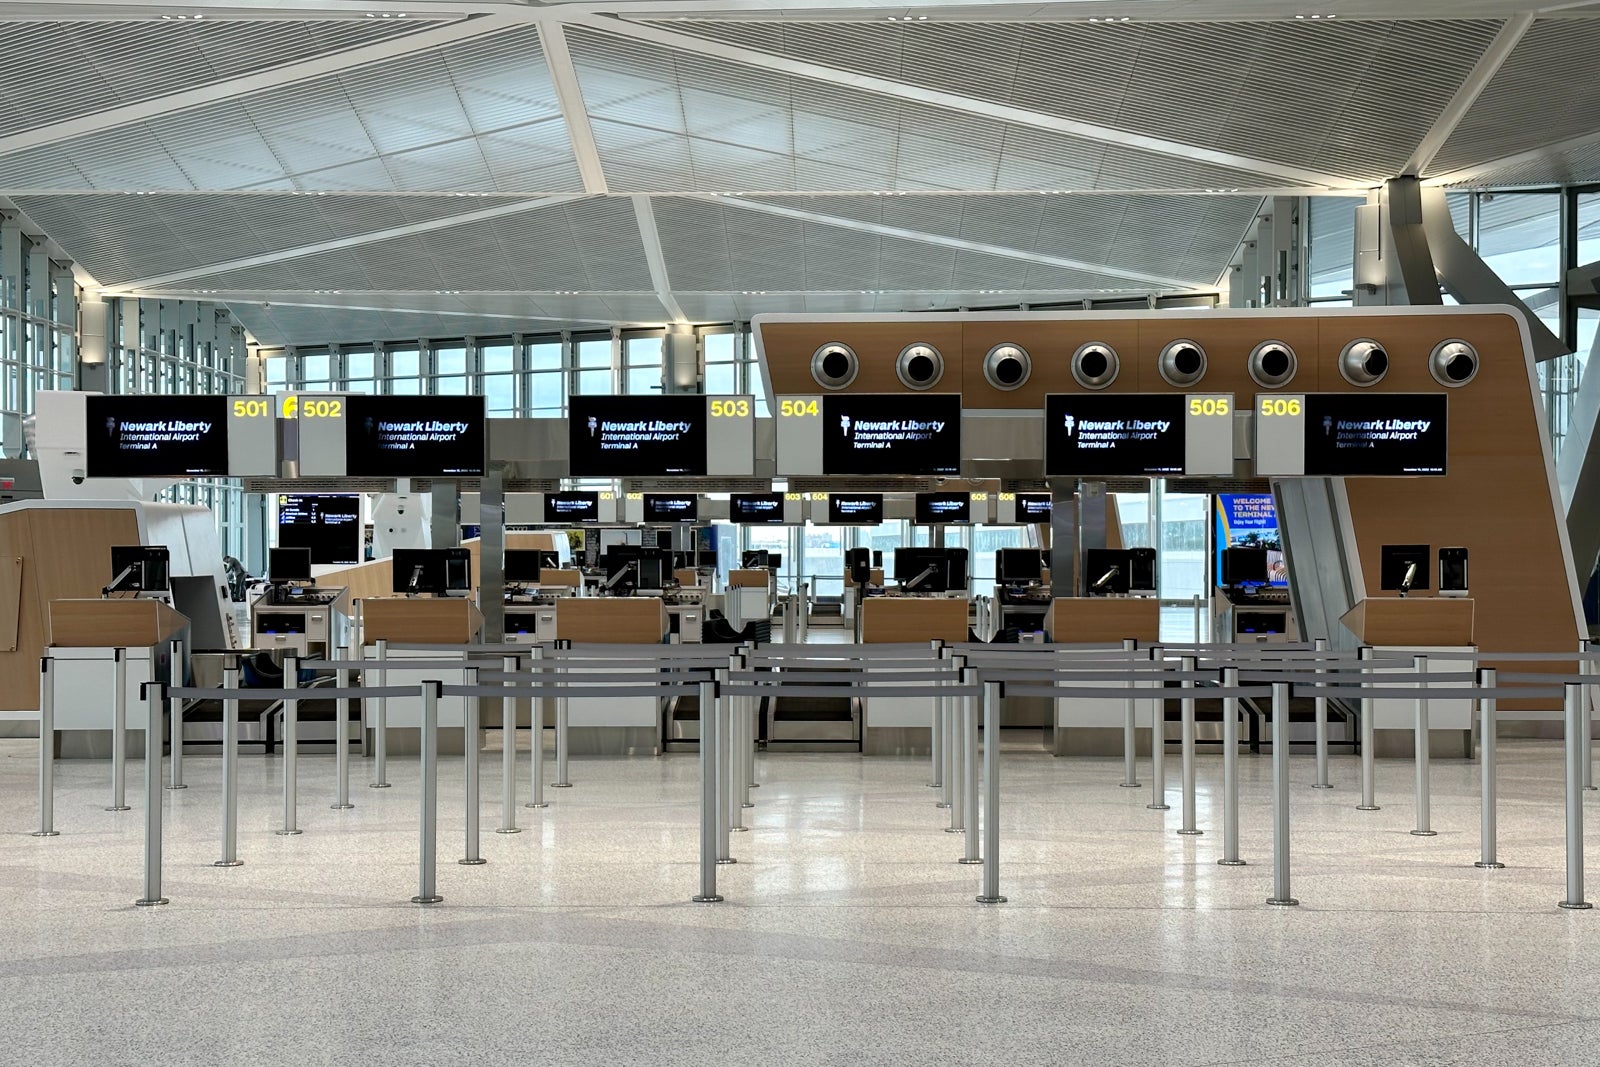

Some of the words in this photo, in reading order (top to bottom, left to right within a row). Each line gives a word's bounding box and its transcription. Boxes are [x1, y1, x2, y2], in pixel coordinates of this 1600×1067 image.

[234, 400, 268, 417] 501
[303, 400, 342, 418] 502
[710, 400, 749, 417] 503
[780, 400, 819, 417] 504
[1189, 398, 1229, 416] 505
[1261, 398, 1302, 417] 506
[120, 421, 167, 431] Newark
[168, 421, 212, 433] Liberty
[378, 421, 424, 431] Newark
[425, 421, 469, 433] Liberty
[601, 421, 647, 431] Newark
[648, 421, 692, 433] Liberty
[854, 420, 900, 431] Newark
[901, 420, 945, 432] Liberty
[1078, 420, 1124, 430] Newark
[1126, 420, 1170, 432] Liberty
[1337, 420, 1384, 430] Newark
[1385, 419, 1431, 432] Liberty
[120, 433, 172, 441] International
[172, 433, 200, 442] Airport
[378, 433, 429, 441] International
[430, 433, 456, 442] Airport
[601, 433, 652, 441] International
[652, 433, 679, 442] Airport
[854, 432, 905, 440] International
[906, 432, 932, 441] Airport
[1078, 432, 1130, 440] International
[1130, 432, 1158, 441] Airport
[1337, 432, 1389, 440] International
[1389, 431, 1418, 441] Airport
[600, 492, 614, 500] 601
[785, 492, 801, 501] 603
[812, 492, 828, 501] 604
[971, 493, 988, 501] 605
[998, 492, 1015, 501] 606
